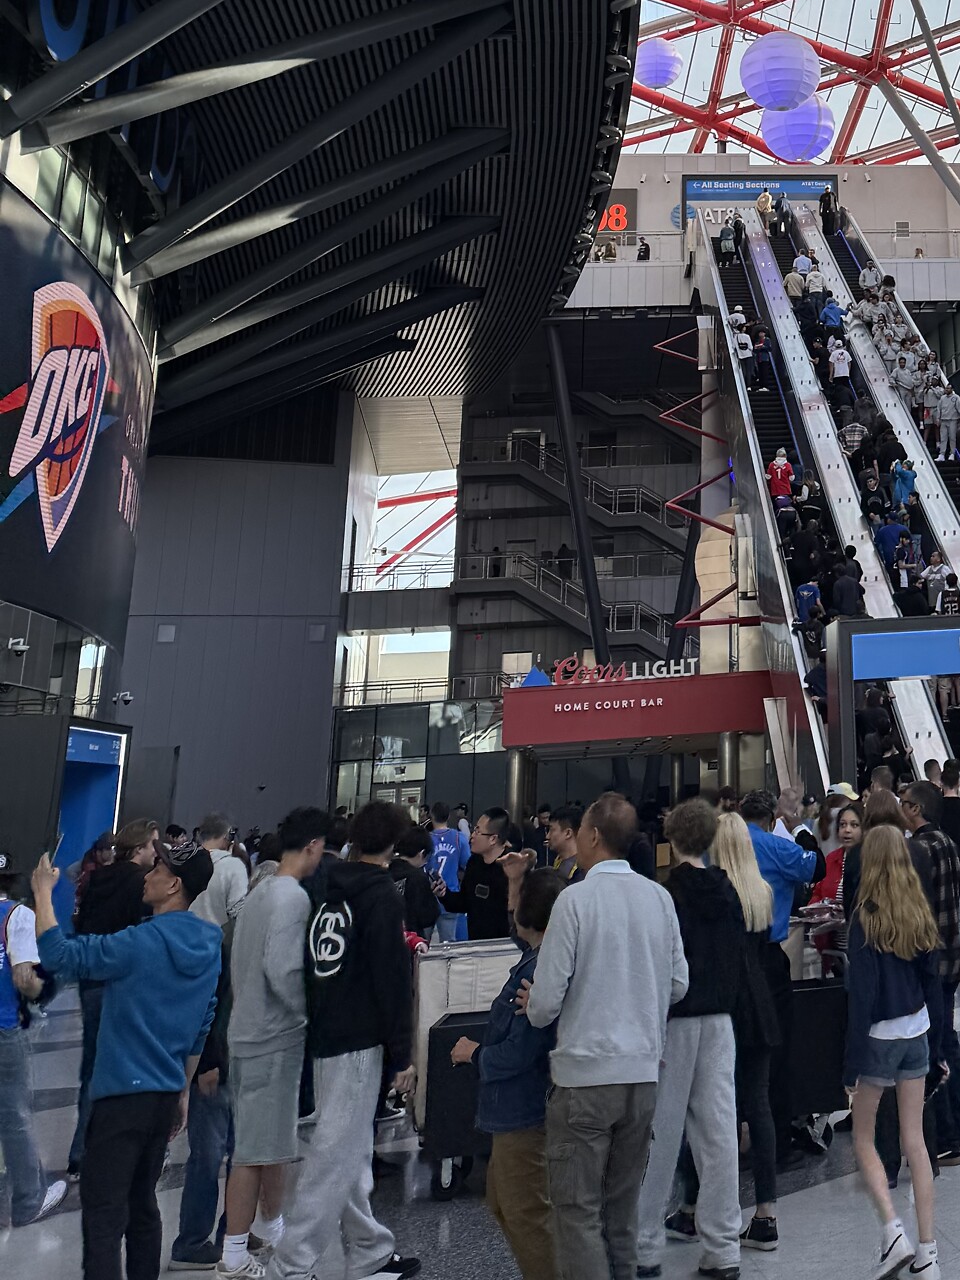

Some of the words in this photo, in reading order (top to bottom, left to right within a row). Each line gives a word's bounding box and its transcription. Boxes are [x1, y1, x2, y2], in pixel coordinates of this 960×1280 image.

[714, 181, 744, 189] Seating
[9, 347, 98, 477] OKC
[553, 656, 629, 685] Coors
[631, 658, 699, 679] LIGHT
[554, 702, 590, 712] HOME
[595, 699, 636, 710] COURT
[641, 698, 664, 707] BAR
[437, 856, 447, 875] 7
